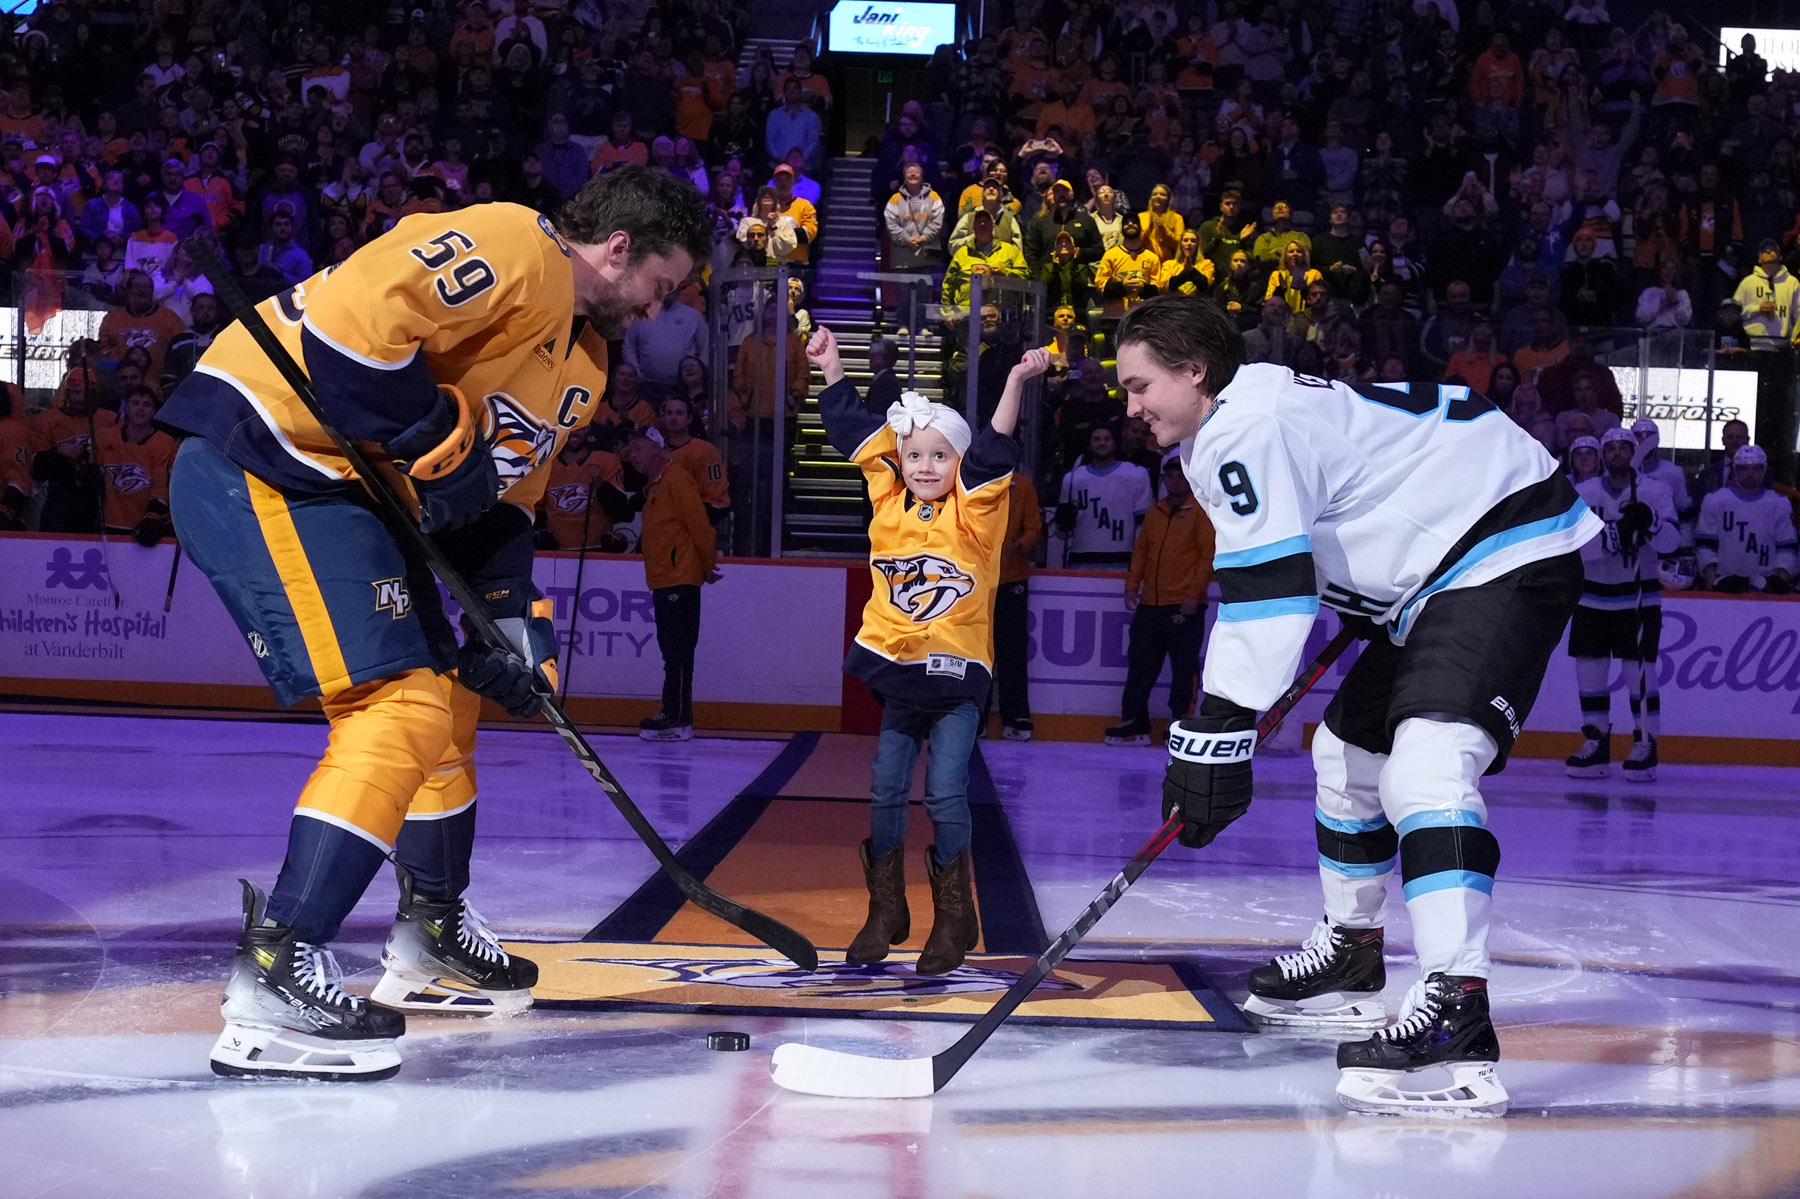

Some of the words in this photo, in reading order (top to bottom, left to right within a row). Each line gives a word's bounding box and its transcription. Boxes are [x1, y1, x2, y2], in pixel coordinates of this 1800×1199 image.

[853, 5, 900, 24] Jani
[408, 228, 498, 308] 59
[1756, 286, 1786, 318] UTH
[557, 385, 591, 429] C
[707, 463, 721, 480] 10
[1218, 460, 1261, 517] 9
[1078, 489, 1125, 541] UTAH
[1723, 511, 1769, 567] UTAH
[27, 593, 73, 607] Monroe
[85, 609, 166, 640] Hospital
[24, 642, 38, 656] at
[43, 641, 124, 660] Vanderbilt
[949, 658, 963, 668] S/M
[1490, 695, 1520, 742] Baue
